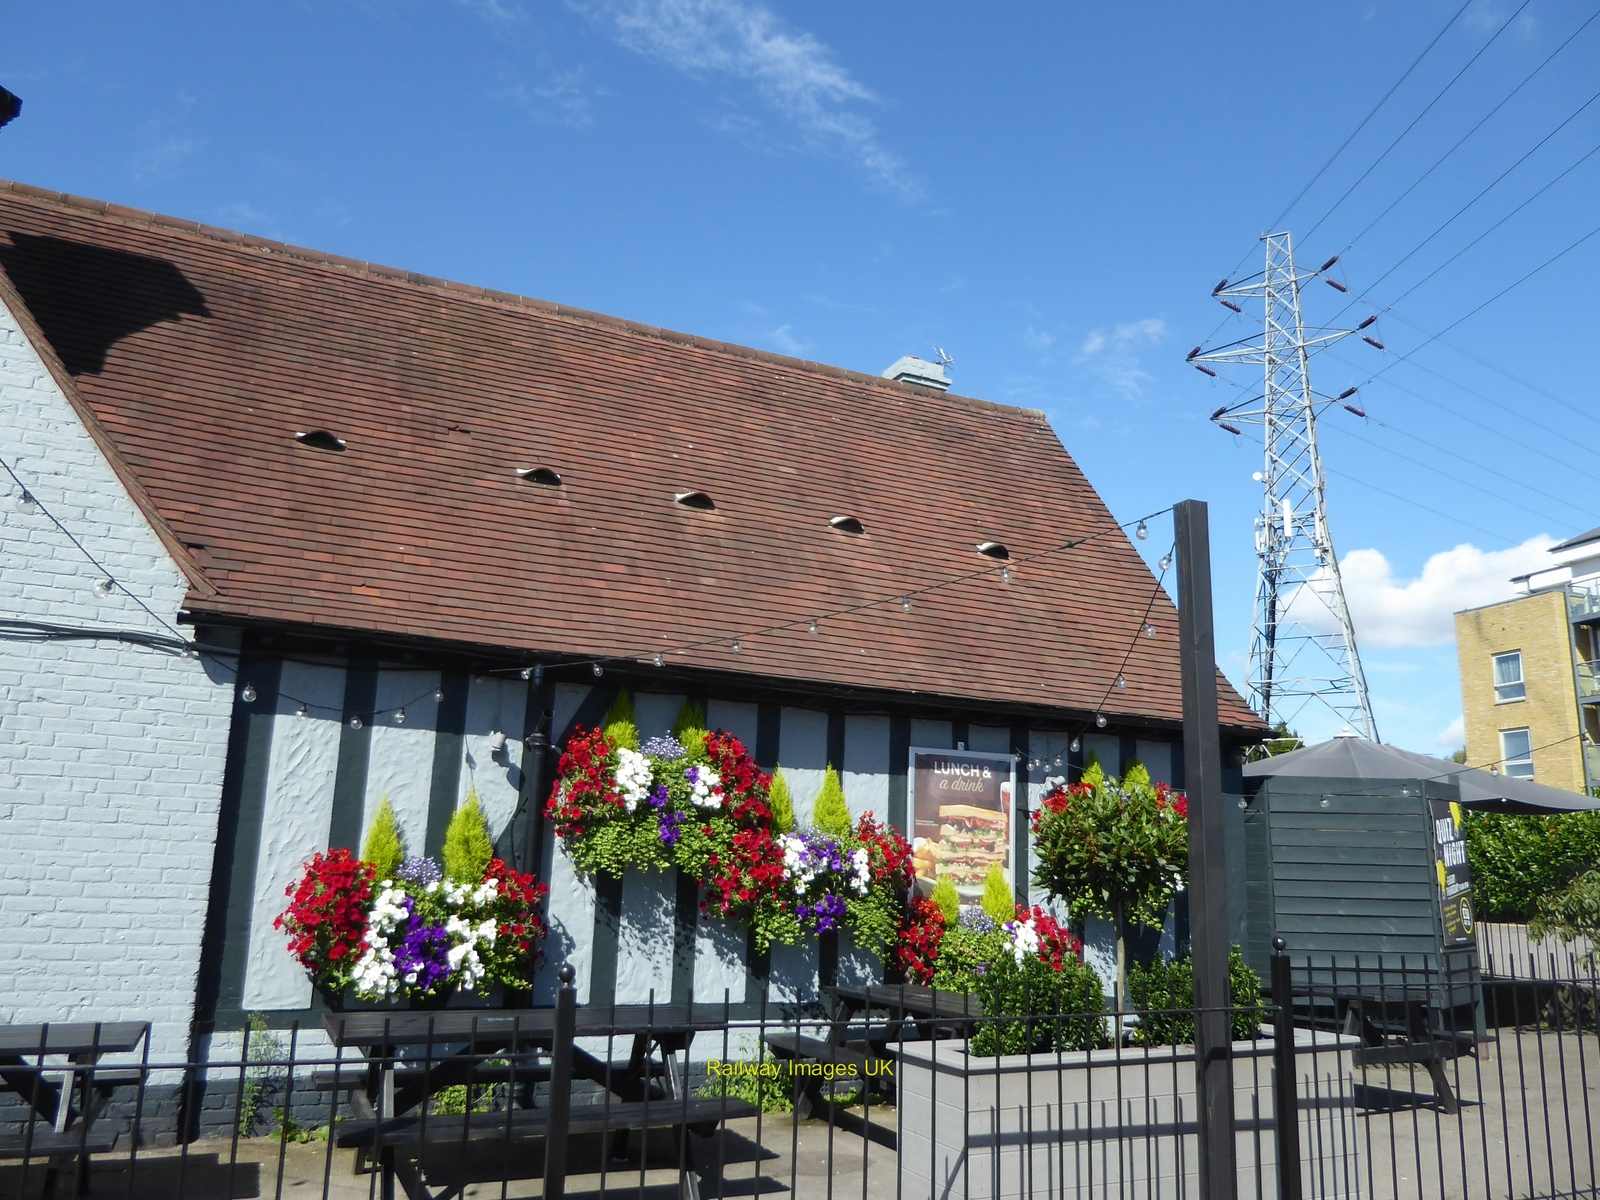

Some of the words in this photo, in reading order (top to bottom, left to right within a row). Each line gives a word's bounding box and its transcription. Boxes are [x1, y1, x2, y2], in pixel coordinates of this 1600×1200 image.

[934, 761, 980, 777] LUNCH
[982, 765, 992, 779] &
[939, 779, 949, 789] a
[951, 777, 984, 792] drink
[1435, 817, 1454, 845] QUIZ
[1443, 840, 1466, 868] NIGHT
